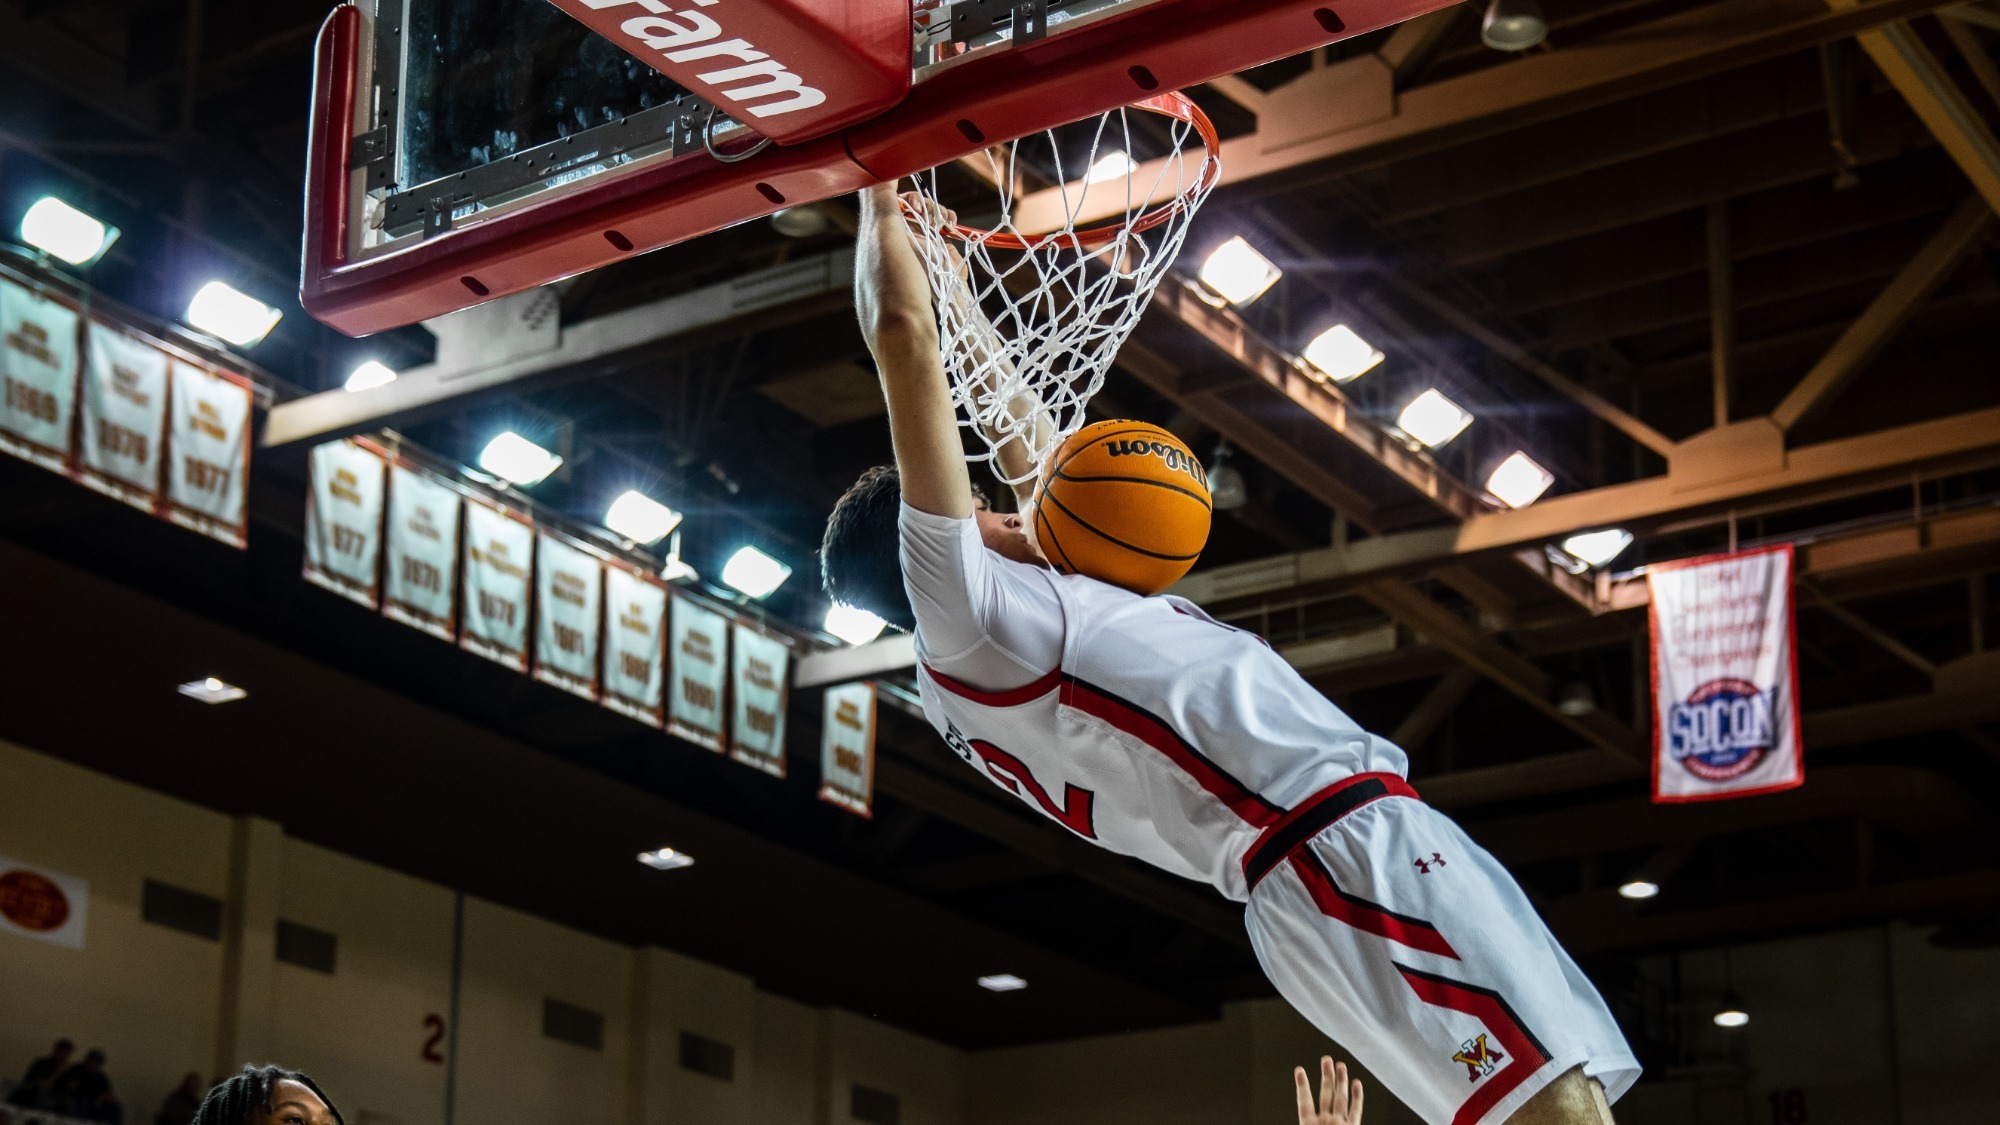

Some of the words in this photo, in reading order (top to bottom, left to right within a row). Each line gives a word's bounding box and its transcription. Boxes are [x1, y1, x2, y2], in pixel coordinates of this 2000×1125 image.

[1106, 440, 1209, 493] Wilson
[1670, 687, 1779, 762] SOCON
[423, 1013, 445, 1064] 2
[1768, 1087, 1806, 1125] 18
